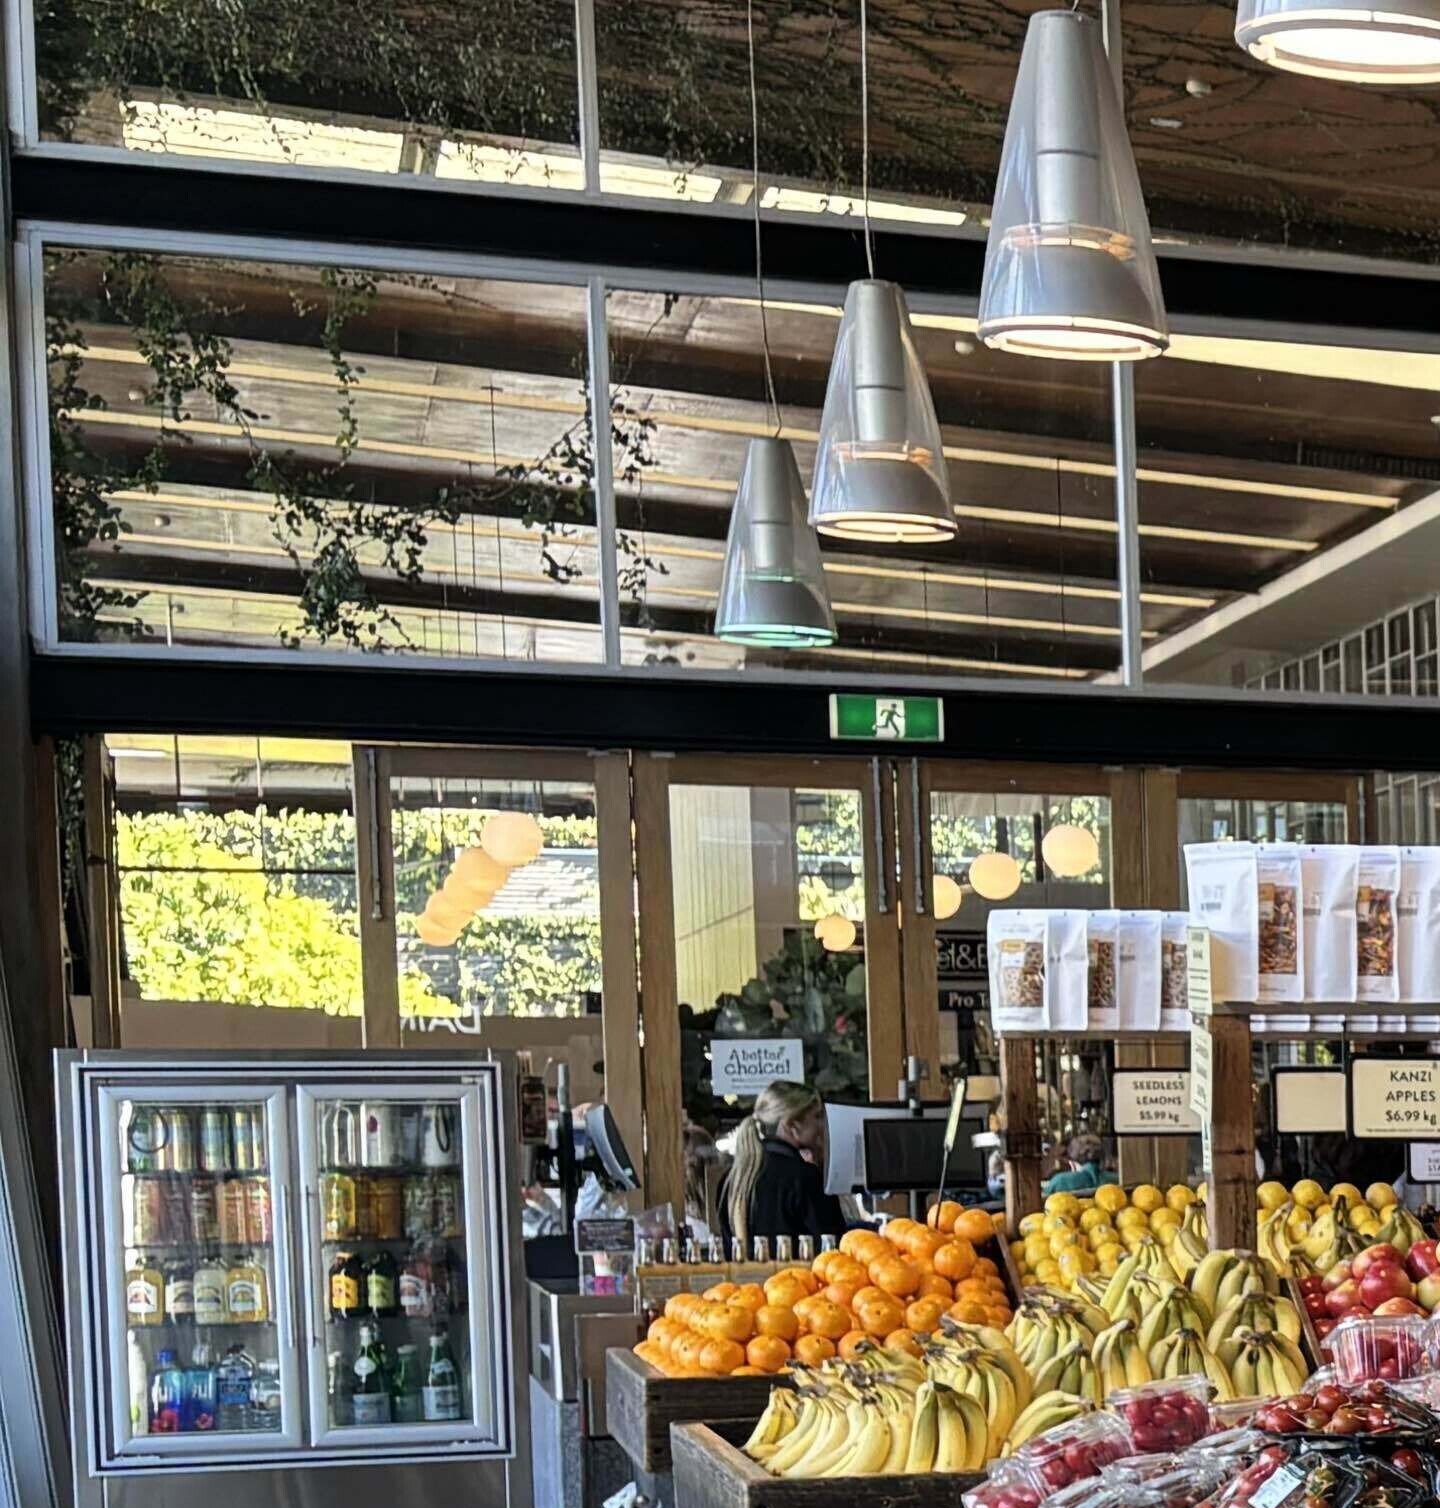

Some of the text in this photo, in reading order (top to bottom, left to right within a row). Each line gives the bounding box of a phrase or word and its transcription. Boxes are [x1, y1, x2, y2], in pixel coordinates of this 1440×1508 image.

[1390, 1071, 1432, 1082] KANZI
[1136, 1096, 1181, 1105] LEMONS
[1386, 1091, 1436, 1102] APPLES
[1386, 1110, 1437, 1126] $6.99 kg
